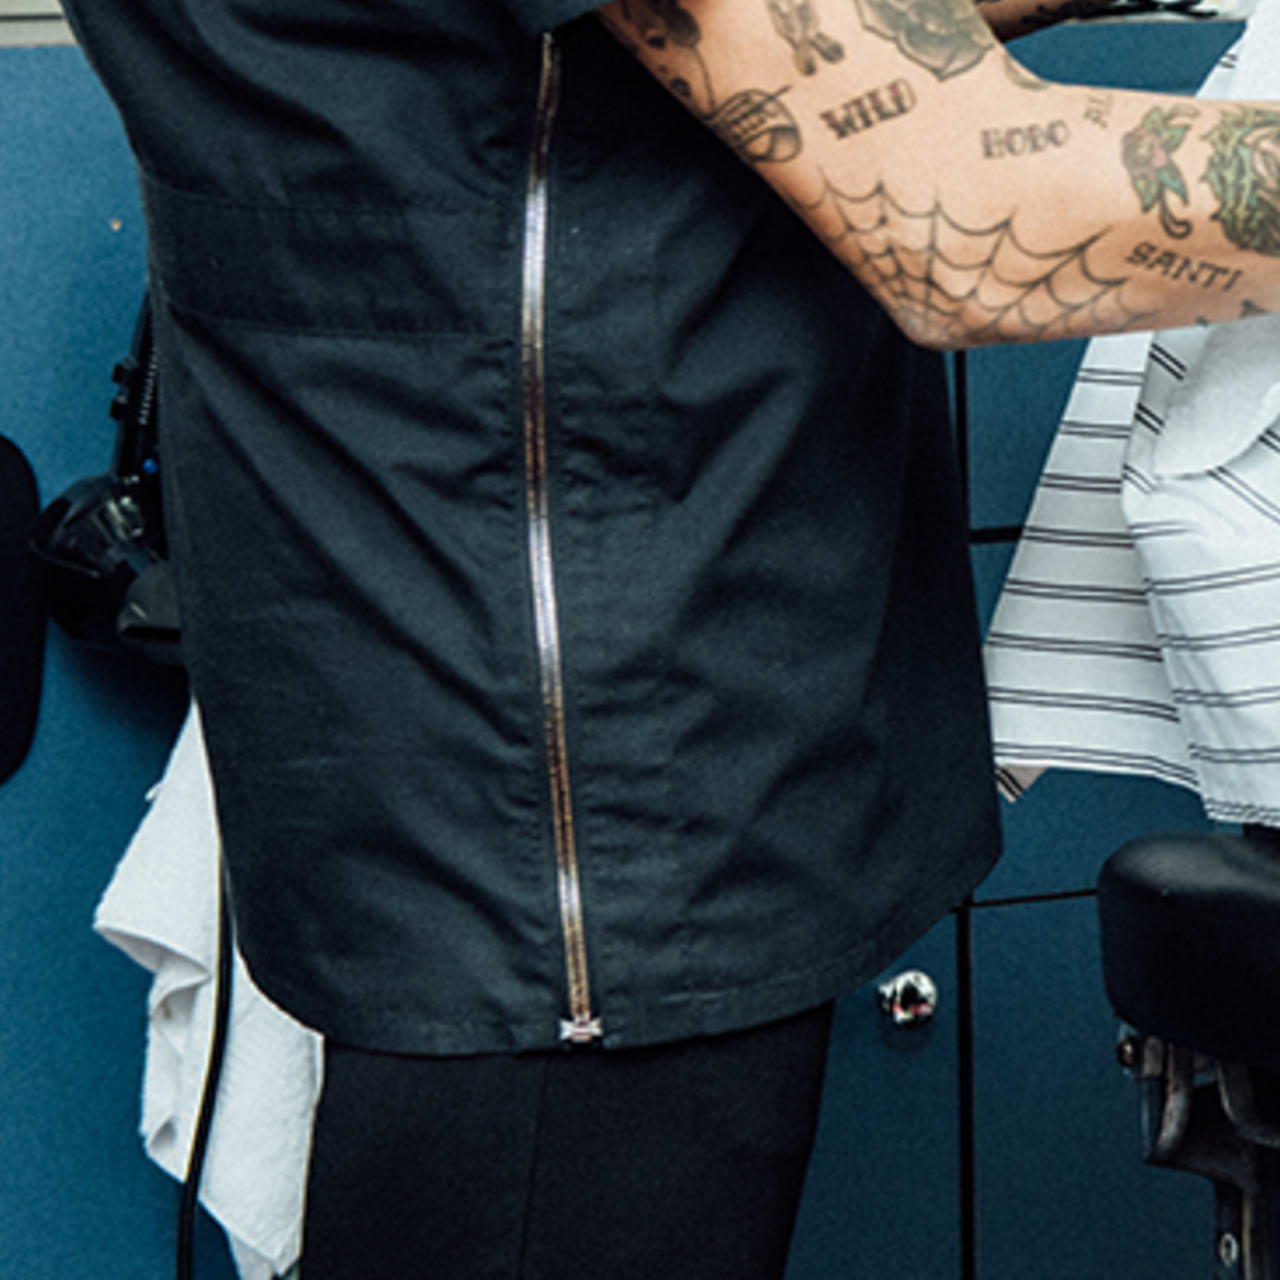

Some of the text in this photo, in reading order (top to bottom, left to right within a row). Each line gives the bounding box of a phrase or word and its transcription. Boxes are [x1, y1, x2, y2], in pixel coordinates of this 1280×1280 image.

[819, 77, 1072, 160] WILD HOBO
[1123, 239, 1246, 292] SANTI
